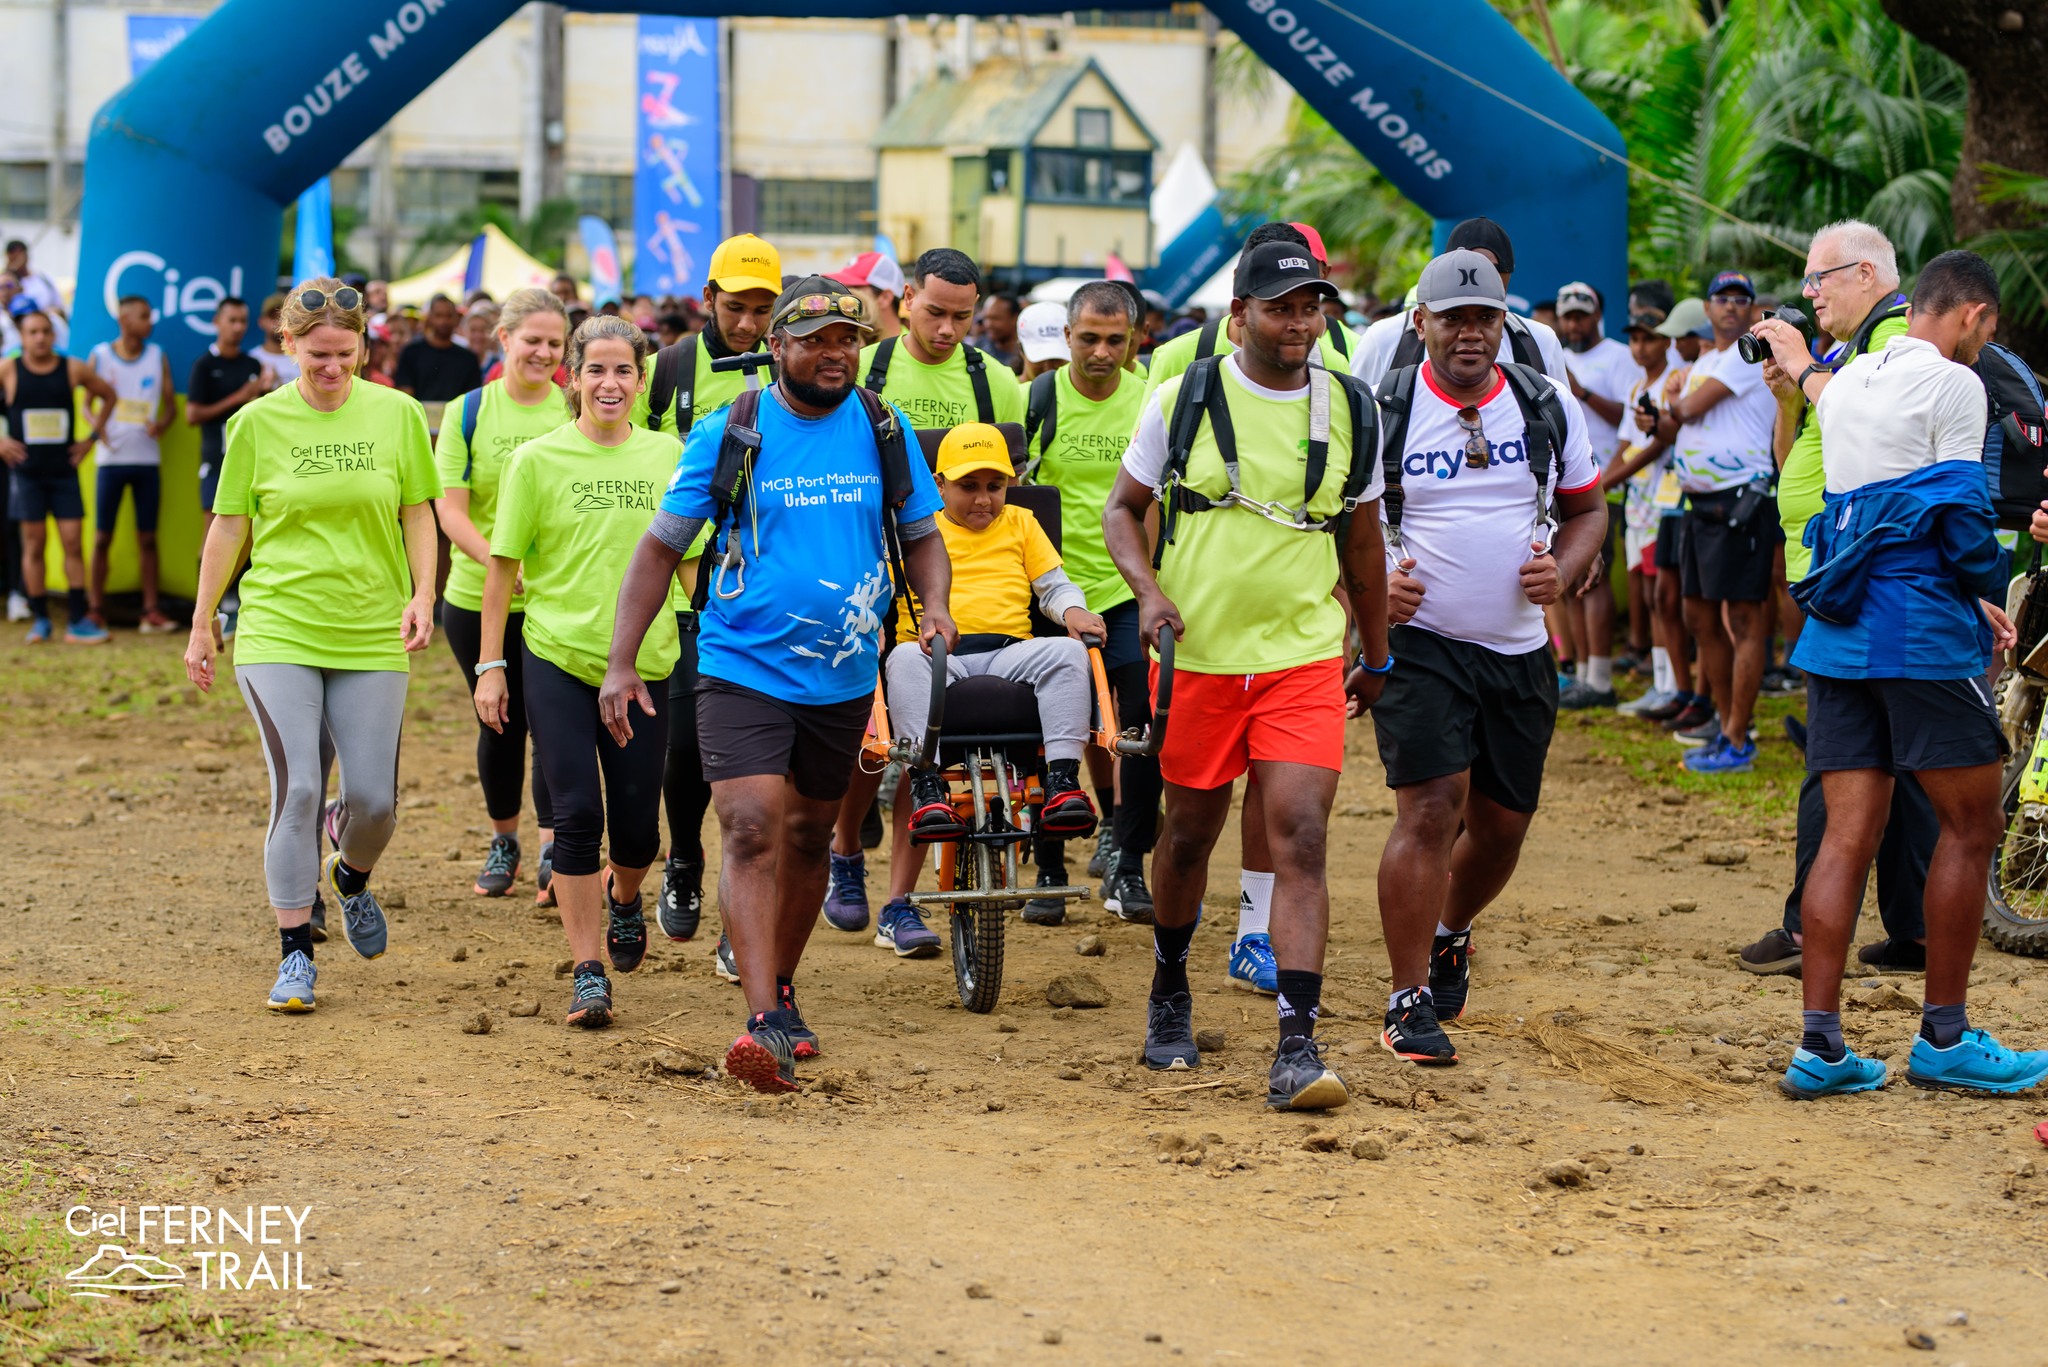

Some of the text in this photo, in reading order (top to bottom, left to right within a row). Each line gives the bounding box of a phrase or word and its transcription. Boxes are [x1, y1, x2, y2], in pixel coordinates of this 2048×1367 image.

[1246, 0, 1453, 180] BOUZE MORIS
[262, 52, 369, 154] BOUZE
[741, 256, 771, 268] sunlife
[103, 250, 243, 336] Ciel
[692, 404, 712, 416] Ciel
[892, 398, 967, 416] Ciel FERNEY
[291, 442, 375, 459] Ciel FERNEY
[962, 439, 994, 450] sunlife
[1097, 449, 1123, 462] TRA
[1403, 432, 1531, 480] crytal
[336, 457, 377, 472] TRAIL
[571, 480, 655, 495] Ciel FERNEY
[761, 471, 879, 493] MCB Port Mathurin
[617, 495, 656, 511] TRAIL
[783, 487, 862, 508] Urban Trail
